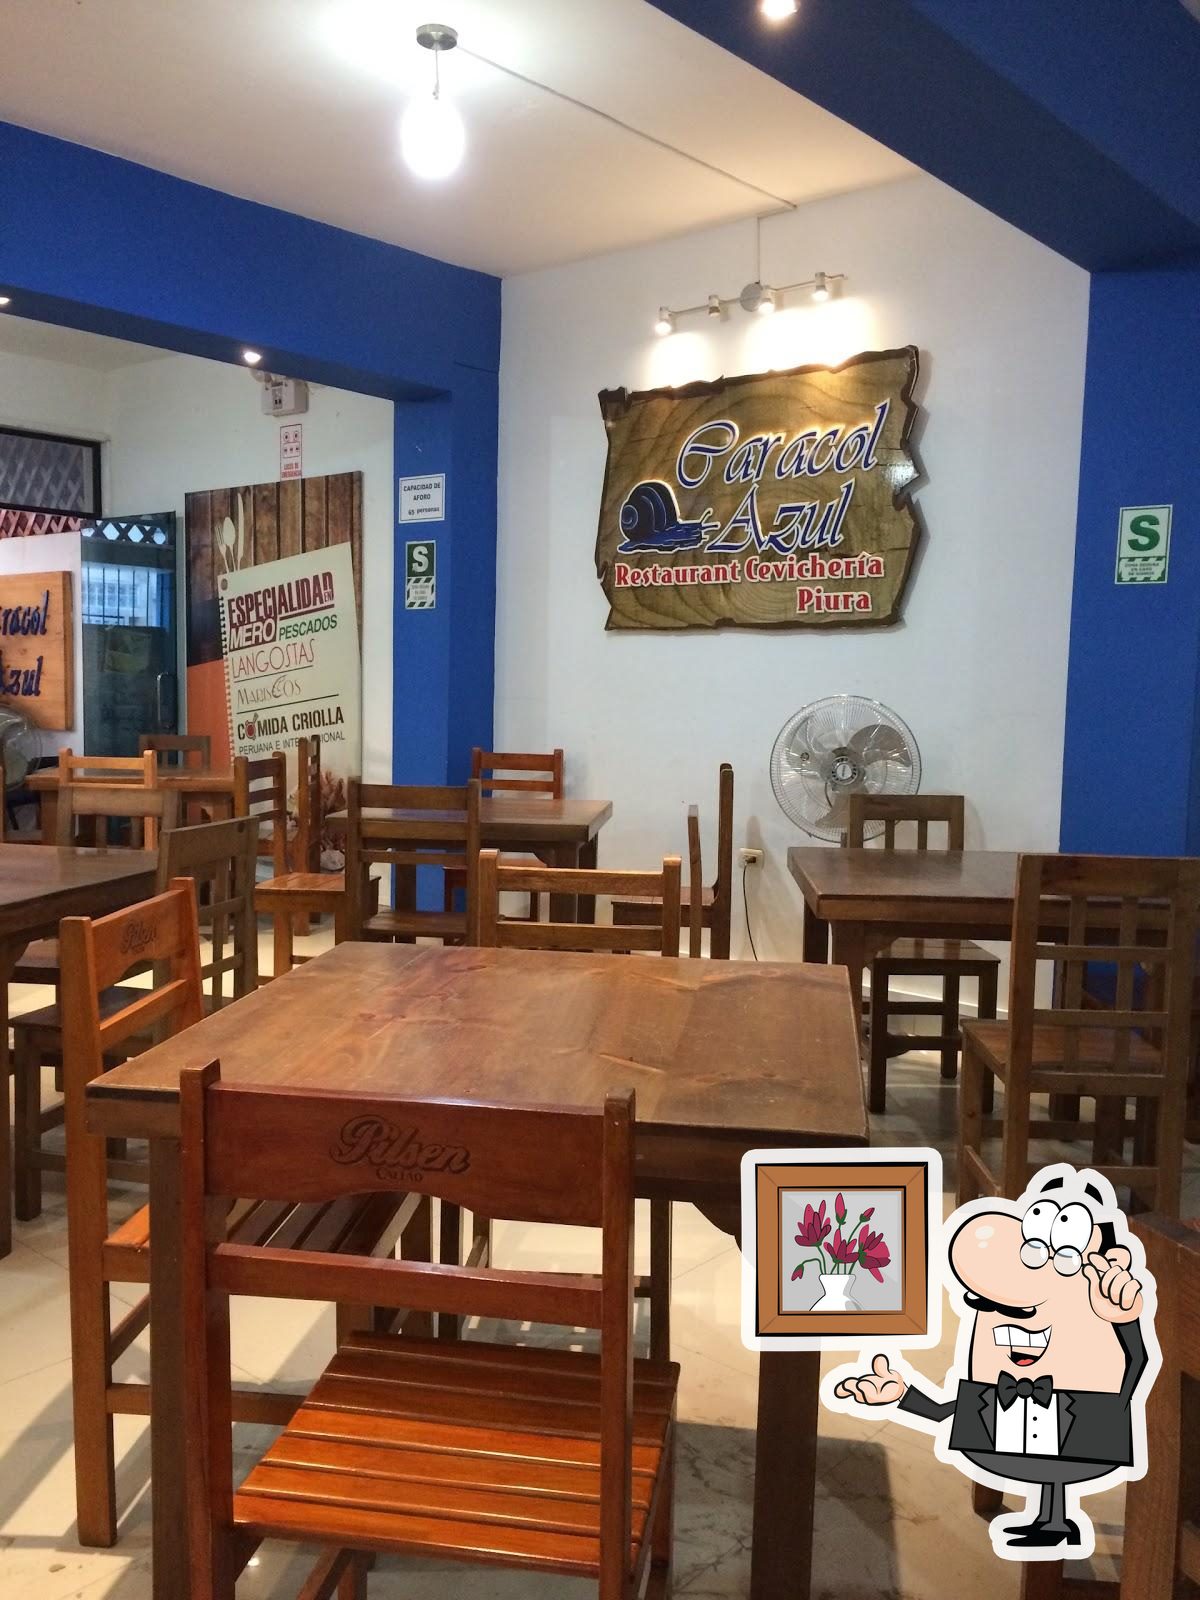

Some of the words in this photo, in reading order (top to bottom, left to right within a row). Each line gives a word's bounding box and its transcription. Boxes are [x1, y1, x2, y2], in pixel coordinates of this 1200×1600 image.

[676, 397, 891, 489] Caracol
[403, 482, 433, 492] CAPACIDAD
[433, 481, 441, 489] DE
[413, 493, 431, 501] AFORO
[416, 506, 440, 514] personas
[704, 478, 856, 555] Azul
[1127, 514, 1161, 552] S
[412, 545, 429, 573] S
[614, 560, 741, 588] Restaurant
[743, 551, 885, 584] Cevichería
[228, 571, 335, 628] ESPECIALIDAD
[796, 587, 872, 614] Piura
[229, 618, 276, 651] MERO
[279, 614, 338, 641] PESCADOS
[231, 638, 315, 679] LANGOSTAS
[292, 706, 345, 732] CRIOLLA
[239, 740, 274, 756] PERUANA
[275, 740, 281, 750] E
[283, 731, 346, 749] INTEIONAL
[329, 1113, 471, 1174] Pilsen
